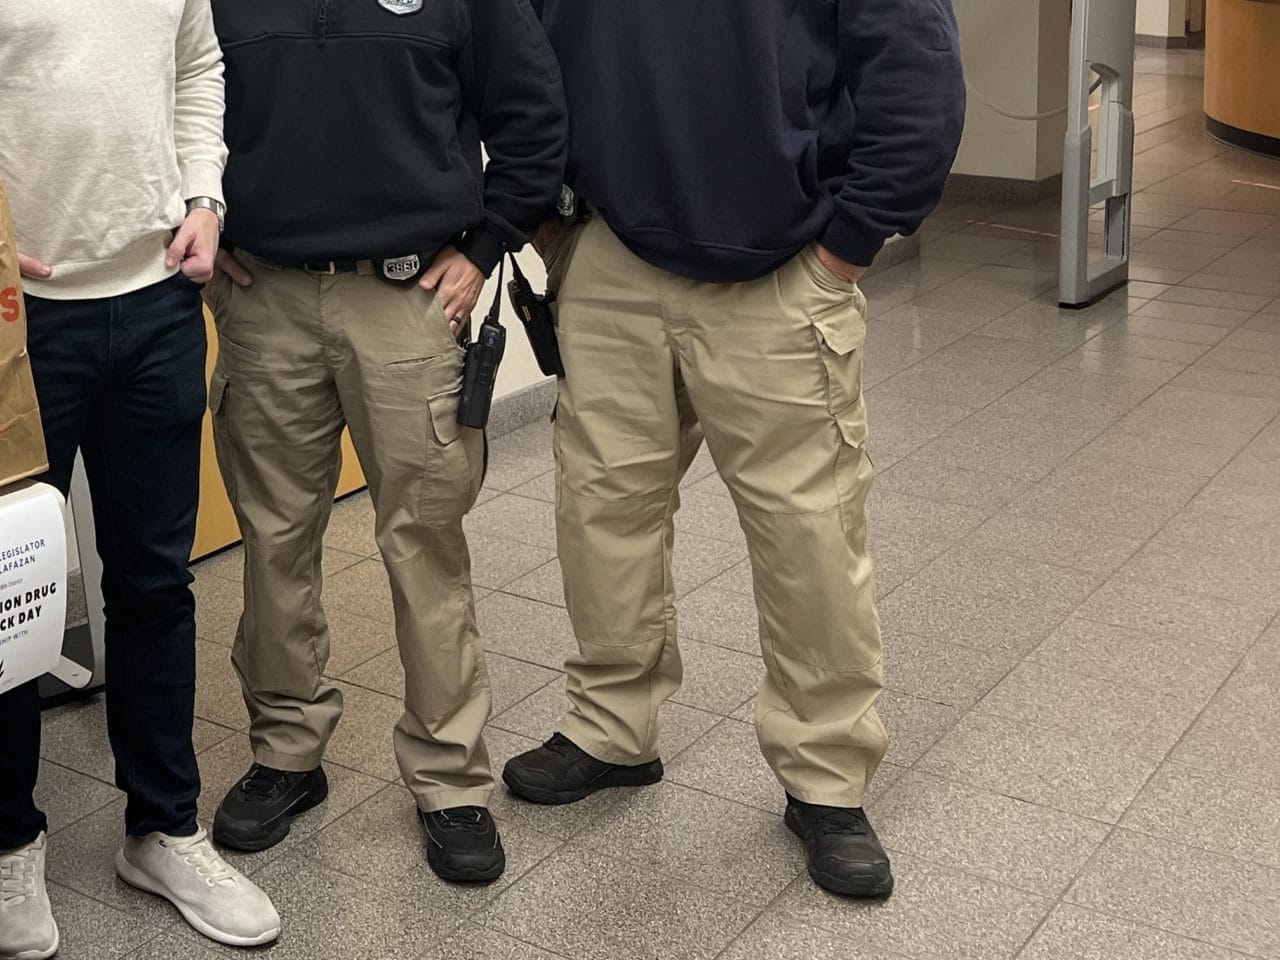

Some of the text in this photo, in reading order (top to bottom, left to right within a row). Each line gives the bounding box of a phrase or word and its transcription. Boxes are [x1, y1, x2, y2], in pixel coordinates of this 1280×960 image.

[25, 582, 57, 604] DRUG
[18, 605, 42, 625] DAY
[13, 630, 29, 641] WITH
